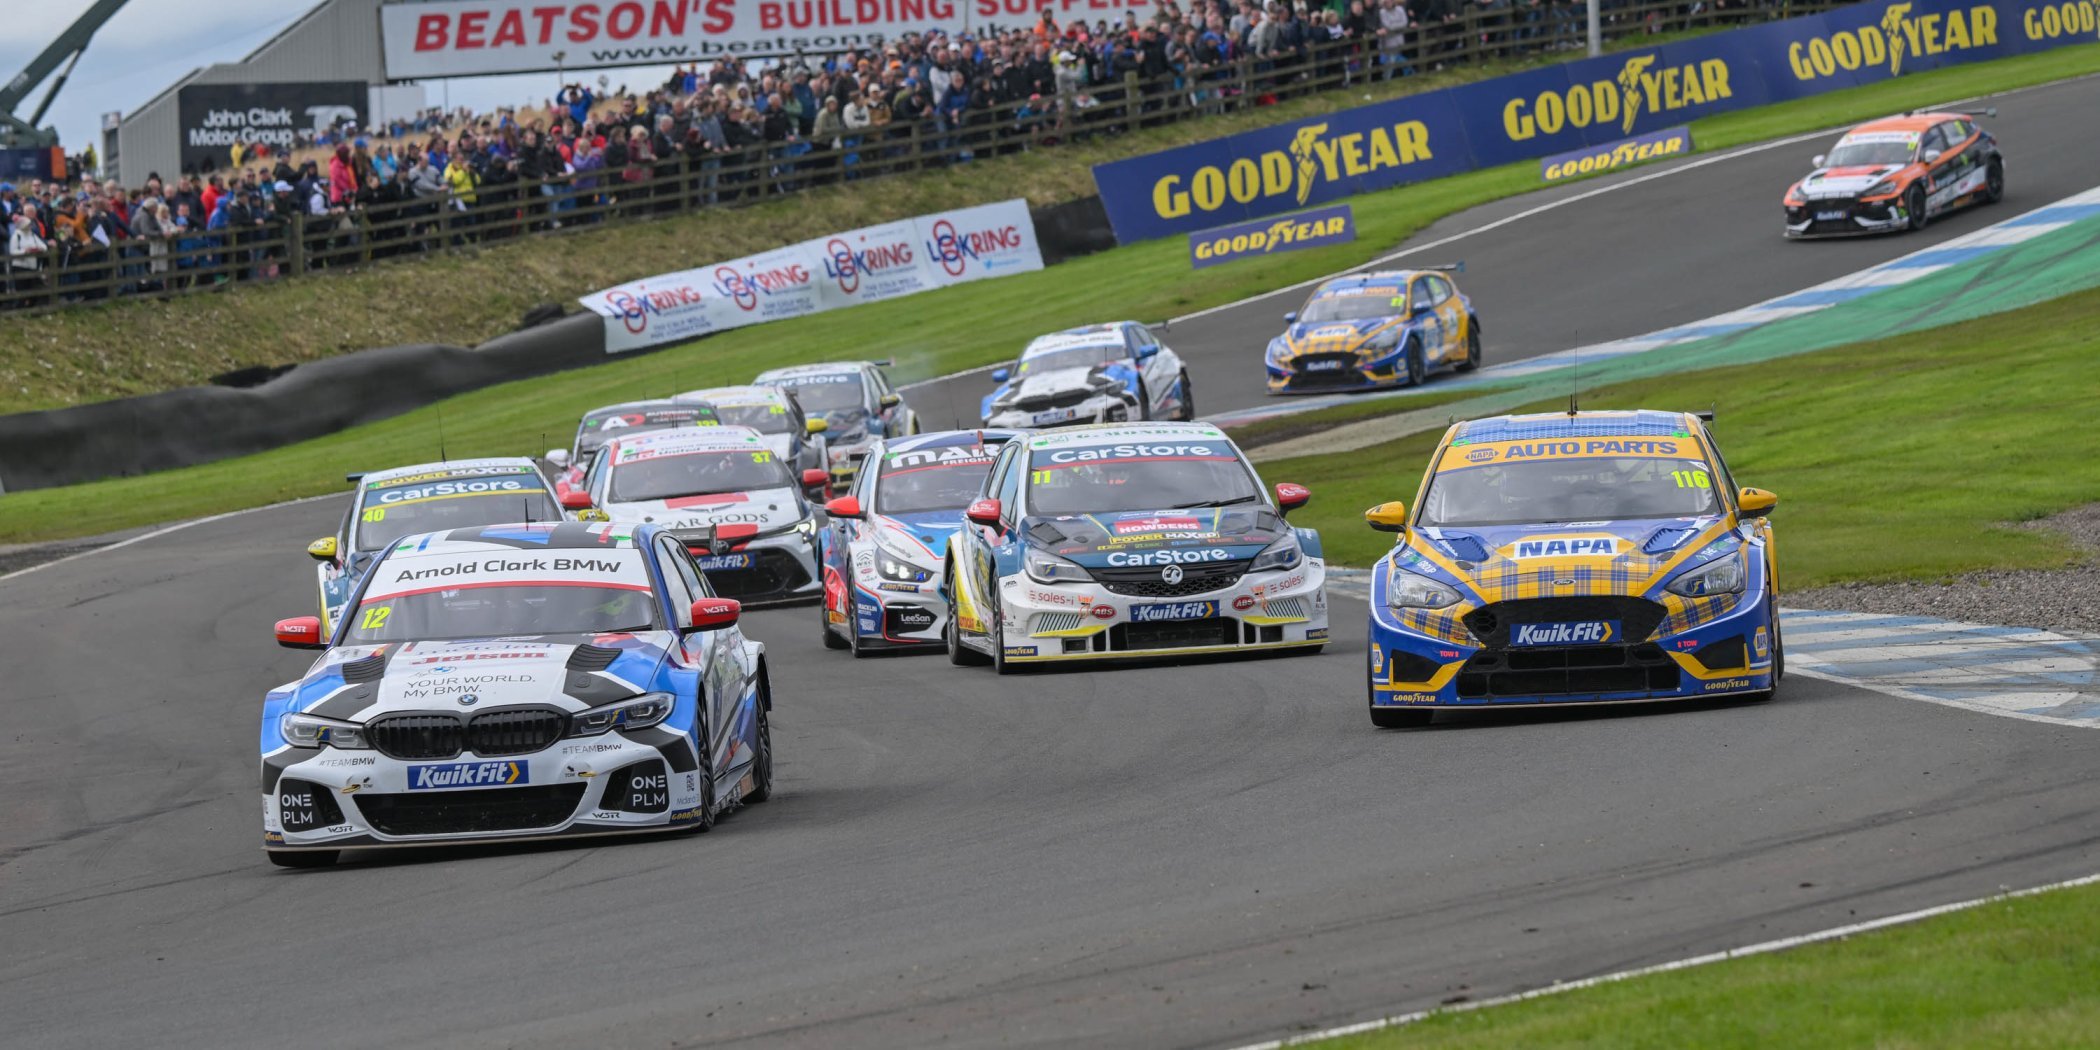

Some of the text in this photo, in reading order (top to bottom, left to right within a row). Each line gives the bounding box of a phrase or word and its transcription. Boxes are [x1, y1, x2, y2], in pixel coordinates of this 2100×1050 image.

[414, 0, 955, 52] BEATSON'S BUILDING
[2024, 1, 2095, 40] GOOD
[1789, 5, 1997, 80] GOODYEAR
[1503, 57, 1732, 141] GOODYEAR
[203, 107, 293, 127] John Clark
[189, 126, 293, 147] Motor Group
[1545, 137, 1682, 180] GOODYEAR
[1152, 120, 1433, 218] GOODYEAR
[1195, 216, 1345, 259] GOODYEAR
[752, 451, 771, 463] 37
[1051, 444, 1212, 463] CarStore
[1505, 443, 1580, 458] AUTO
[1586, 441, 1677, 454] PARTS
[1033, 470, 1051, 484] 11
[1671, 470, 1710, 489] 116
[380, 480, 521, 503] CarStore
[362, 509, 385, 522] 40
[709, 513, 769, 525] GODS
[1119, 523, 1198, 535] HOWDENS
[1520, 539, 1613, 557] NAPA
[1107, 549, 1228, 567] CarStore
[395, 559, 622, 583] Arnold Clark BMW
[361, 607, 391, 630] 12
[901, 614, 931, 622] LeeSan
[1683, 640, 1698, 648] TOW
[407, 675, 536, 688] YOUR WORLD.
[1704, 680, 1749, 690] GOODYEAR
[404, 685, 482, 698] My BMW.
[1393, 694, 1436, 702] GOODYEAR
[563, 743, 622, 755] #TEAMBMW
[319, 757, 376, 767] #TEAMBMW
[632, 775, 666, 791] ONE
[281, 794, 312, 807] ONE
[632, 793, 666, 807] PLM
[283, 811, 313, 824] PLM
